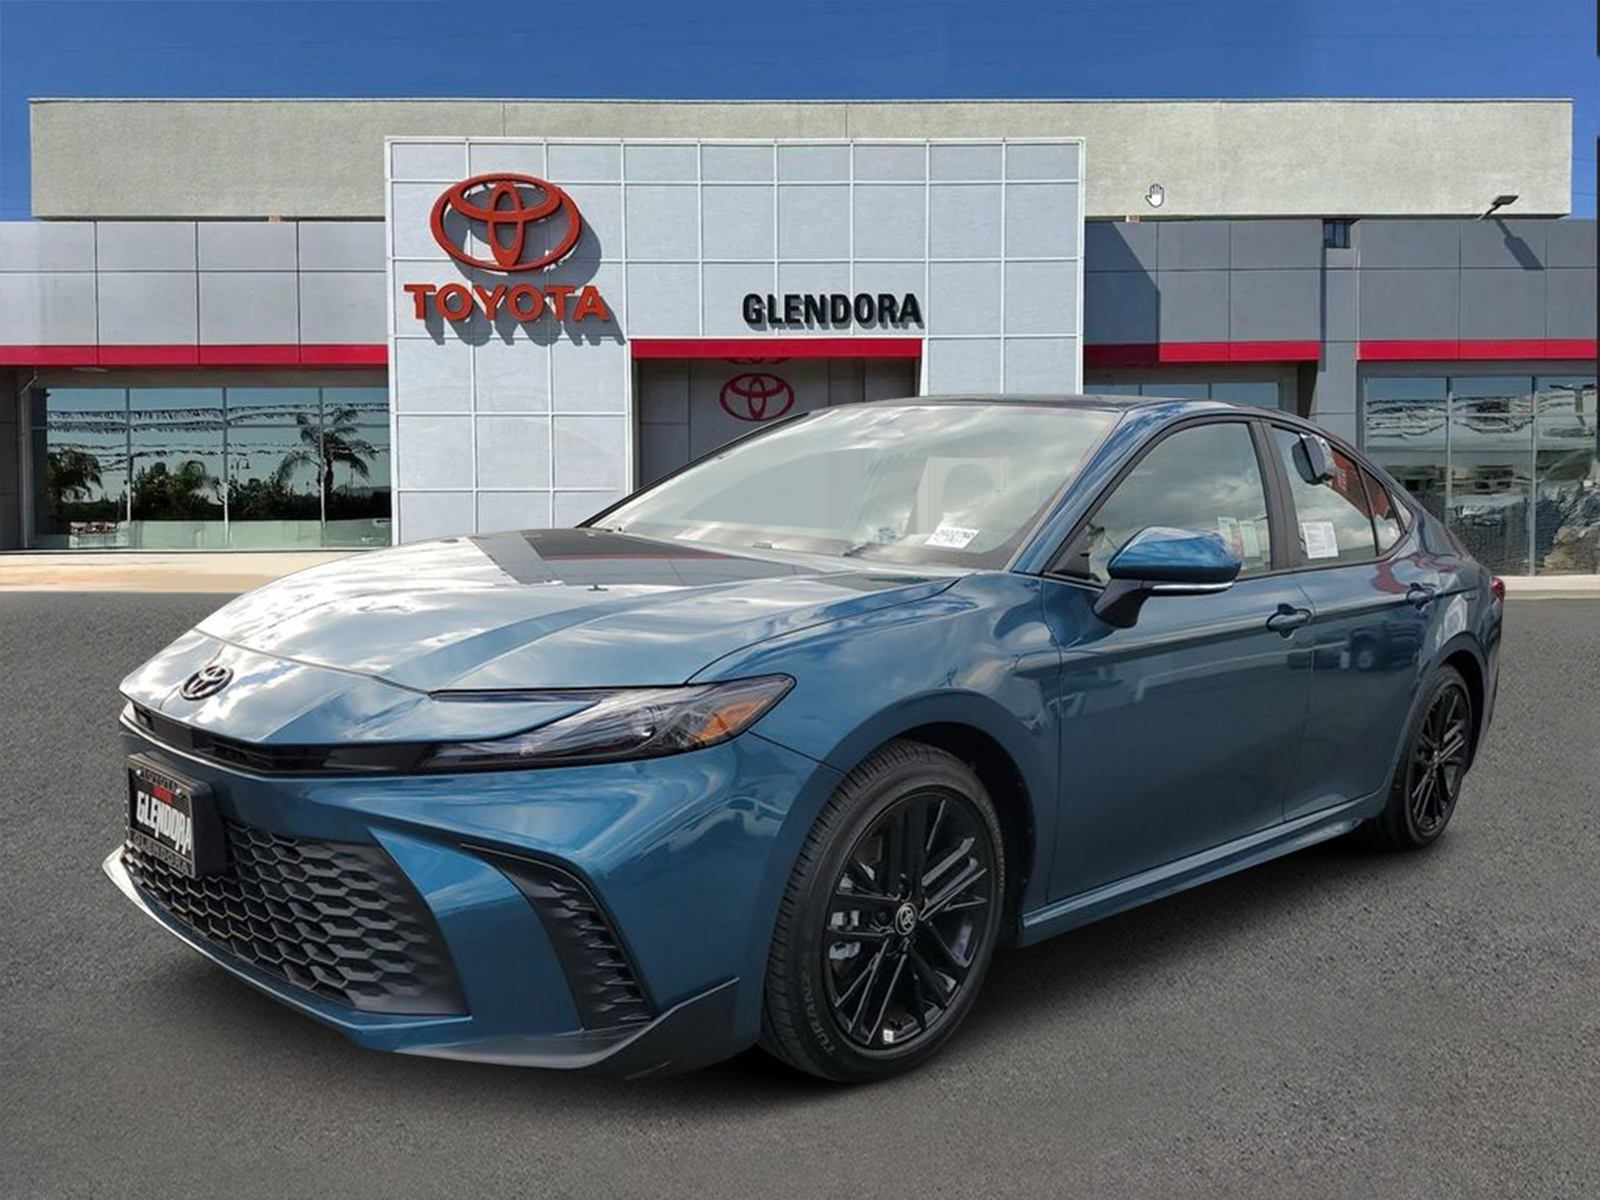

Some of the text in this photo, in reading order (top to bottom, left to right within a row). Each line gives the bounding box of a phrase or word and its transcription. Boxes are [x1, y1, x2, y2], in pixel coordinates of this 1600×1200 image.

[404, 283, 610, 323] TOYOTA
[742, 293, 923, 326] GLENDORA
[136, 790, 192, 856] GLENDORA
[801, 951, 836, 1056] TURANZ
